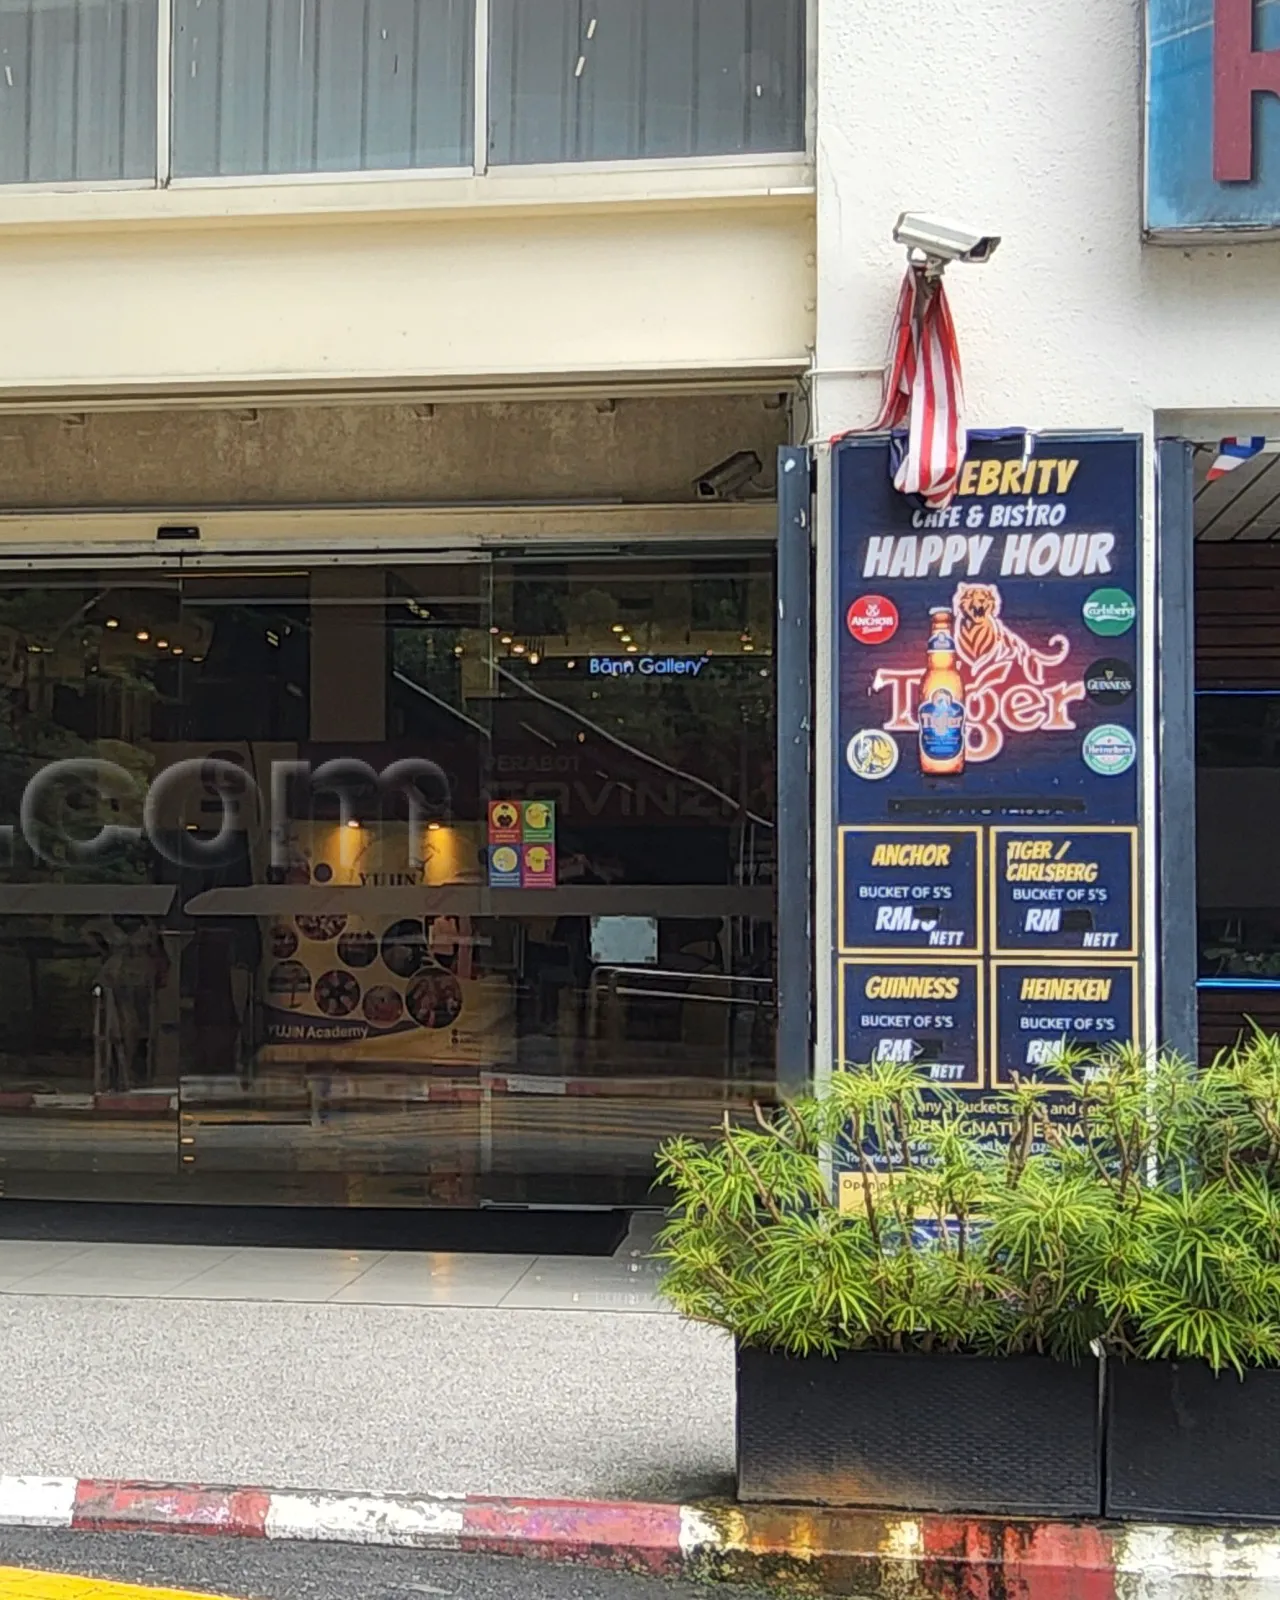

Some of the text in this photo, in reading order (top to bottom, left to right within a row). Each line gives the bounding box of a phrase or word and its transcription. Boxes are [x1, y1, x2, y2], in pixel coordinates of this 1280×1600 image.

[966, 504, 984, 528] &
[989, 502, 1067, 528] BISTRO
[862, 531, 1115, 578] HAPPY HOUR
[1087, 679, 1133, 691] GUINNESS
[872, 661, 1087, 763] Tger
[871, 843, 952, 867] ANCHOR
[1006, 840, 1054, 861] TIGER
[1005, 862, 1099, 883] CARLSBERG
[858, 886, 953, 899] BUCKET OF 5'S
[1012, 887, 1108, 901] BUCKET OF 5'S
[1024, 907, 1062, 932] RM
[928, 931, 965, 946] NETT
[1082, 931, 1119, 947] NETT
[864, 975, 960, 1000] GUINNESS
[1020, 978, 1112, 1002] HEINEKEN
[860, 1015, 954, 1028] BUCKET OF 5'S
[1020, 1016, 1116, 1031] BUCKET OF 5'S
[307, 1025, 369, 1040] Academy
[929, 1063, 965, 1079] NETT
[1050, 1101, 1077, 1115] and
